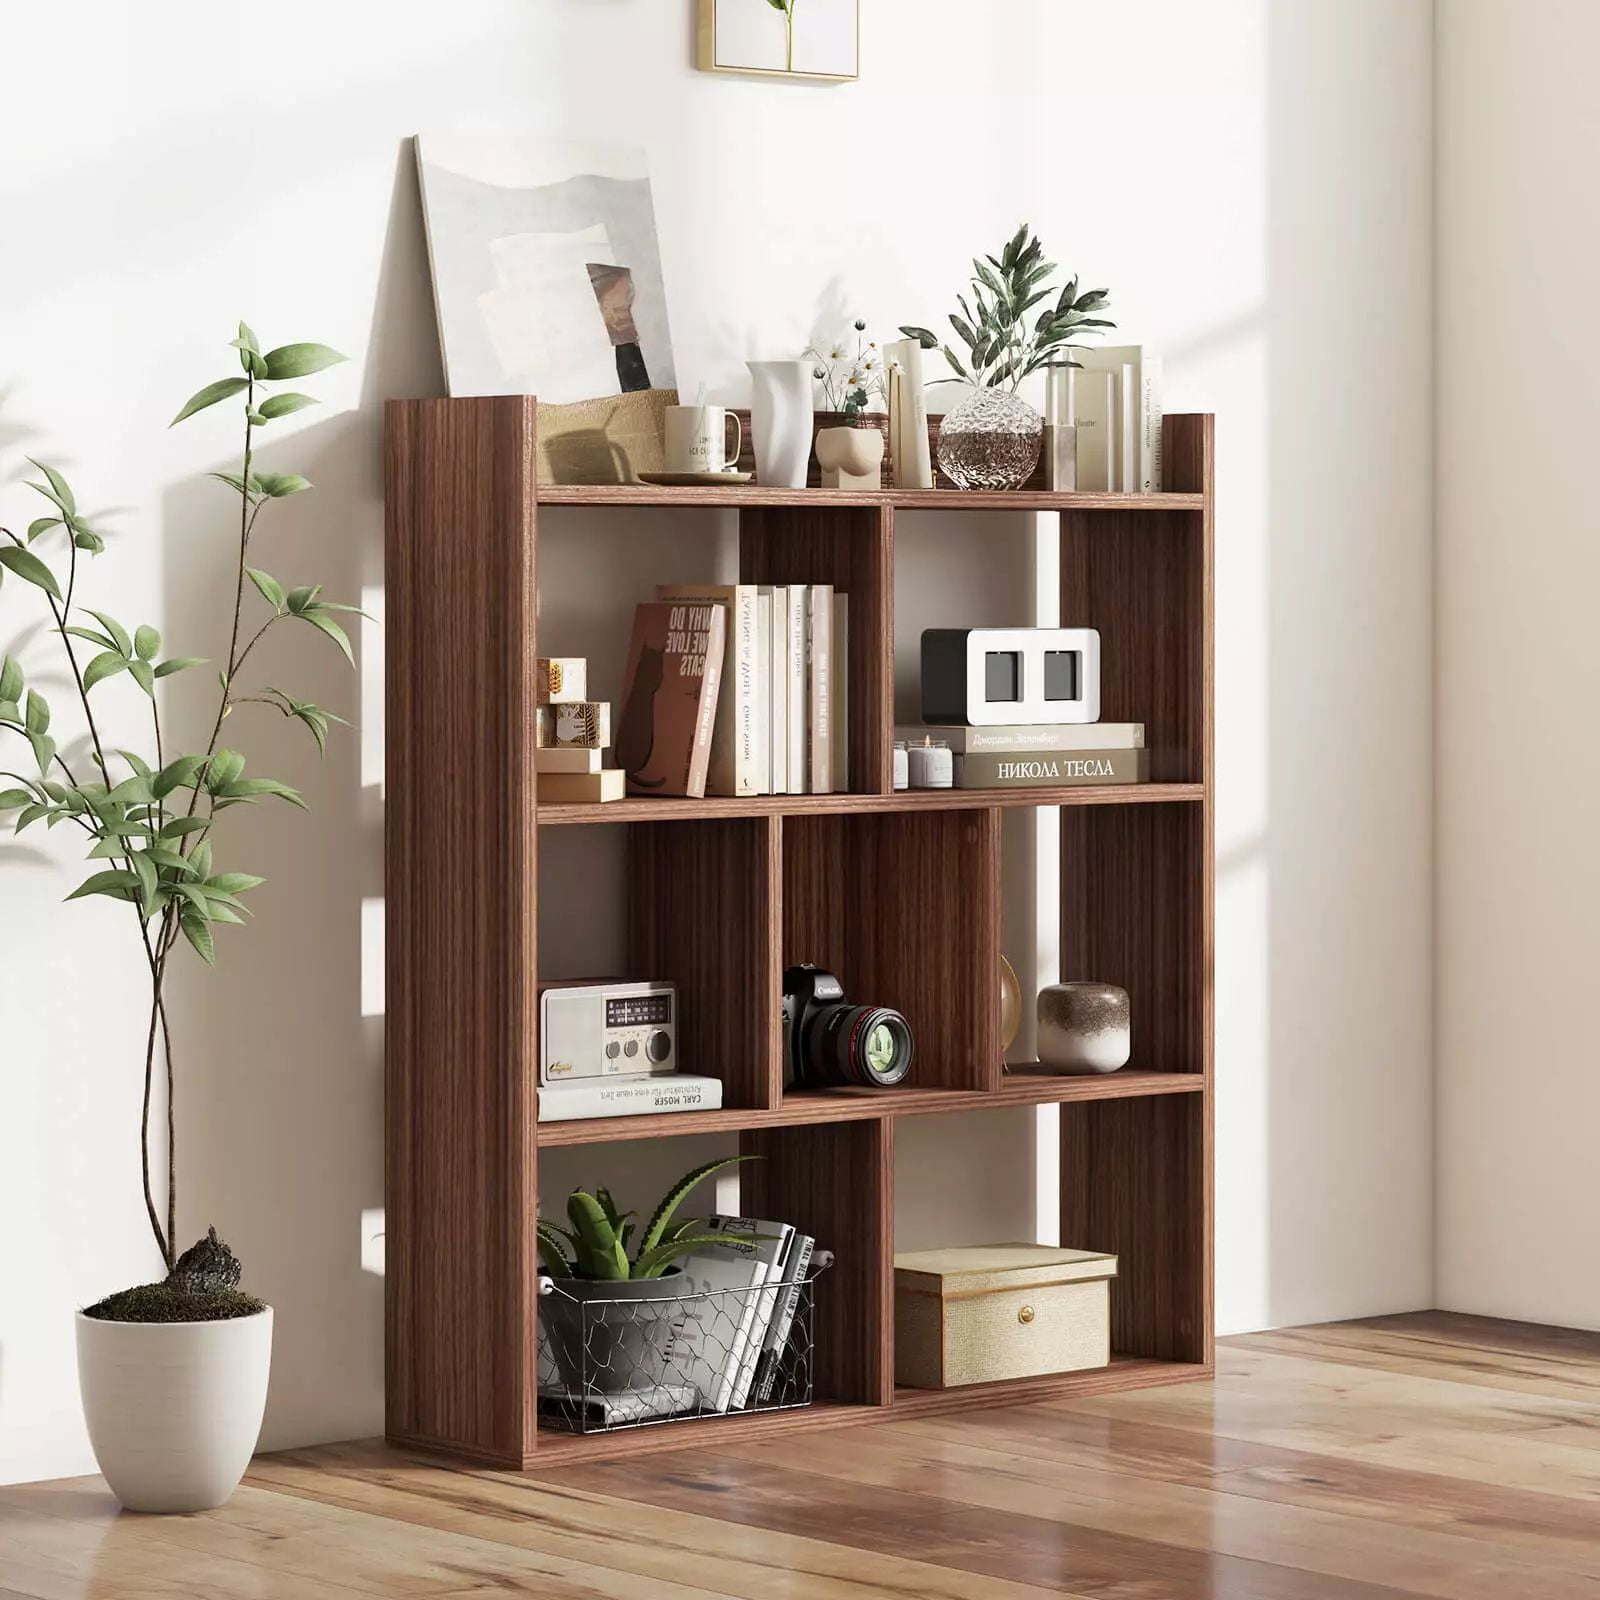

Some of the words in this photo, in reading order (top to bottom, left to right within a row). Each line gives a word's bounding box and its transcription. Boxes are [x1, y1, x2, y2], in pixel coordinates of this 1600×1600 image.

[997, 761, 1060, 779] НИКОЛА
[1064, 759, 1115, 777] ТЕСЛА
[655, 1096, 681, 1106] MOSER
[683, 1094, 702, 1104] CARL
